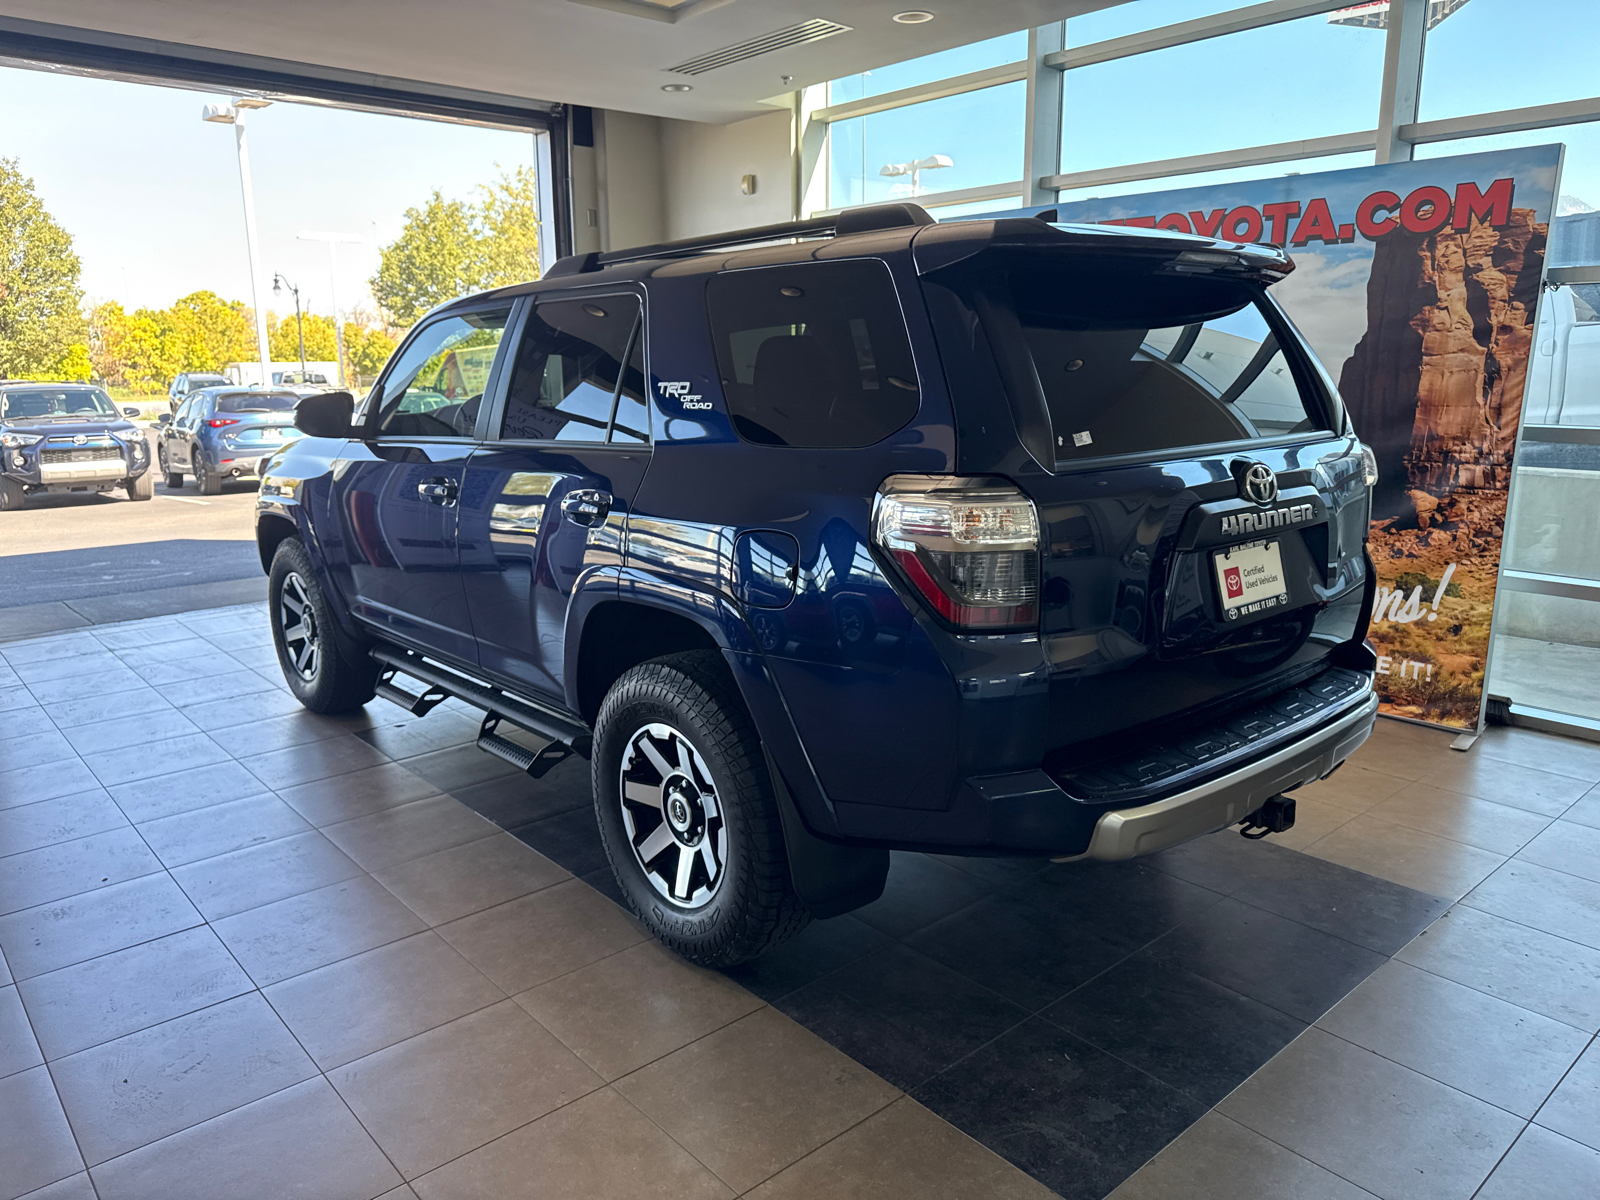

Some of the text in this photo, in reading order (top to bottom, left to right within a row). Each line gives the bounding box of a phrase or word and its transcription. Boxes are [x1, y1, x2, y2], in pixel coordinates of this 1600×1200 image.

[657, 381, 691, 398] TRD
[680, 394, 703, 402] OFF
[682, 402, 713, 410] ROAD
[1221, 503, 1314, 536] 4RUNNER
[1243, 564, 1265, 578] Certified
[1245, 573, 1279, 590] Used Vehicles
[1240, 597, 1277, 615] WE MAKE IT EASY
[1400, 659, 1433, 682] IT!
